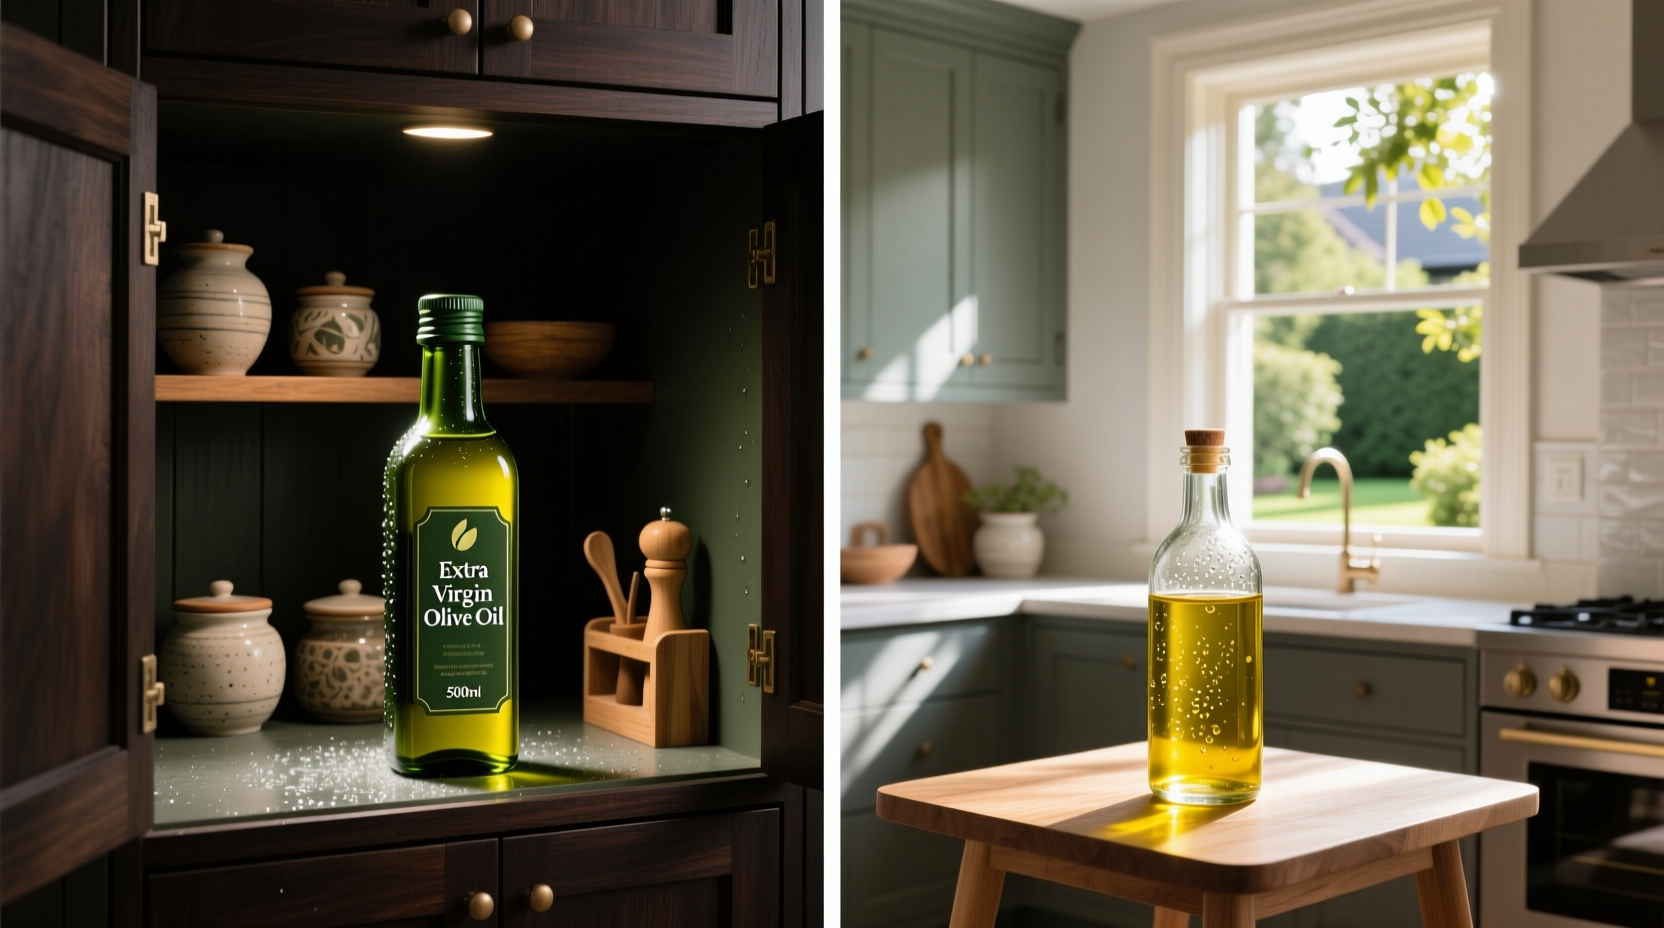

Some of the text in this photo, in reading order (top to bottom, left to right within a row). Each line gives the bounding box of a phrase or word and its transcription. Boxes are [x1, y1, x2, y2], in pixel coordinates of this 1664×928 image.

[439, 561, 488, 579] Extra
[432, 584, 493, 608] Virgin
[424, 606, 504, 626] Olive Oil
